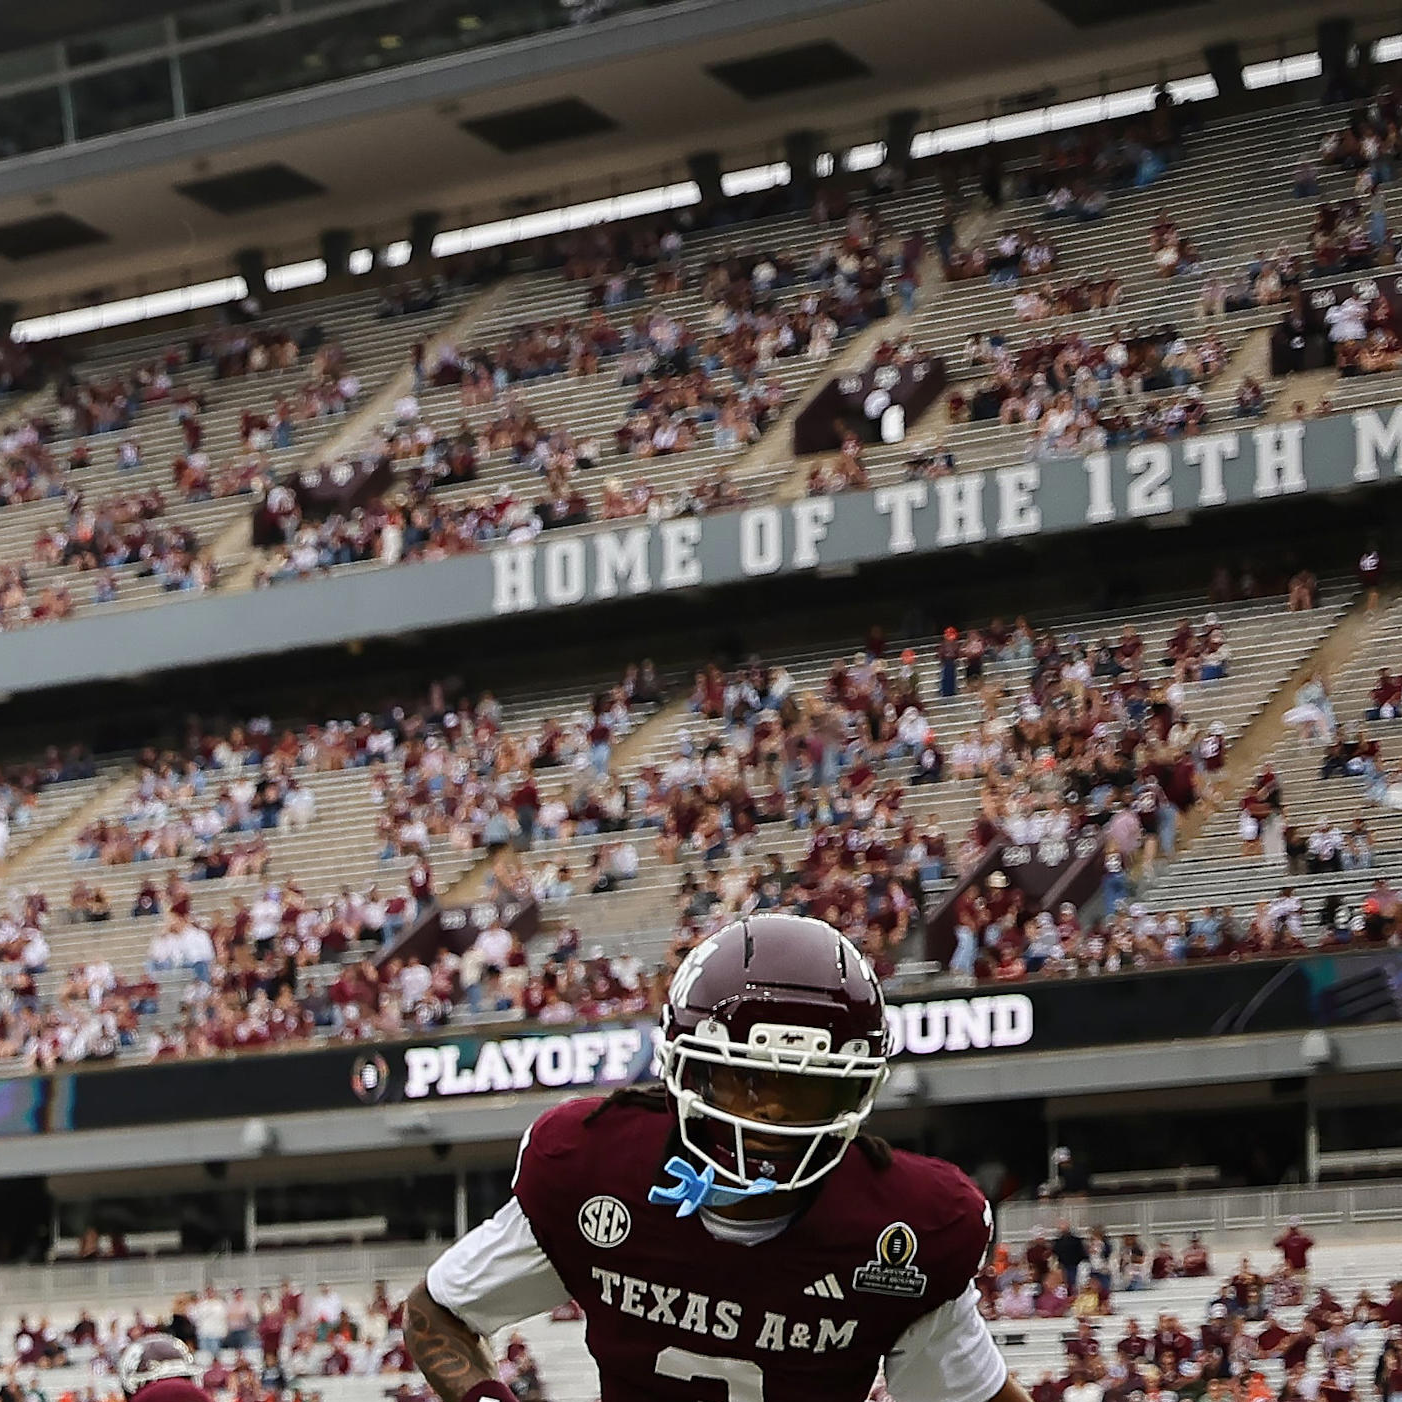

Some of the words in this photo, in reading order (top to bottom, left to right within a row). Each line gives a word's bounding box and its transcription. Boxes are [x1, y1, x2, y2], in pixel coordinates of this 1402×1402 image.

[492, 519, 703, 614] HOME
[740, 498, 835, 576] OF
[874, 463, 1043, 555] THE
[1082, 420, 1308, 523] 12TH
[403, 1026, 642, 1099] PLAYOFF
[885, 994, 1034, 1056] OUND
[584, 1200, 626, 1243] SEC
[592, 1266, 742, 1340] TEXAS
[755, 1311, 859, 1353] A&M
